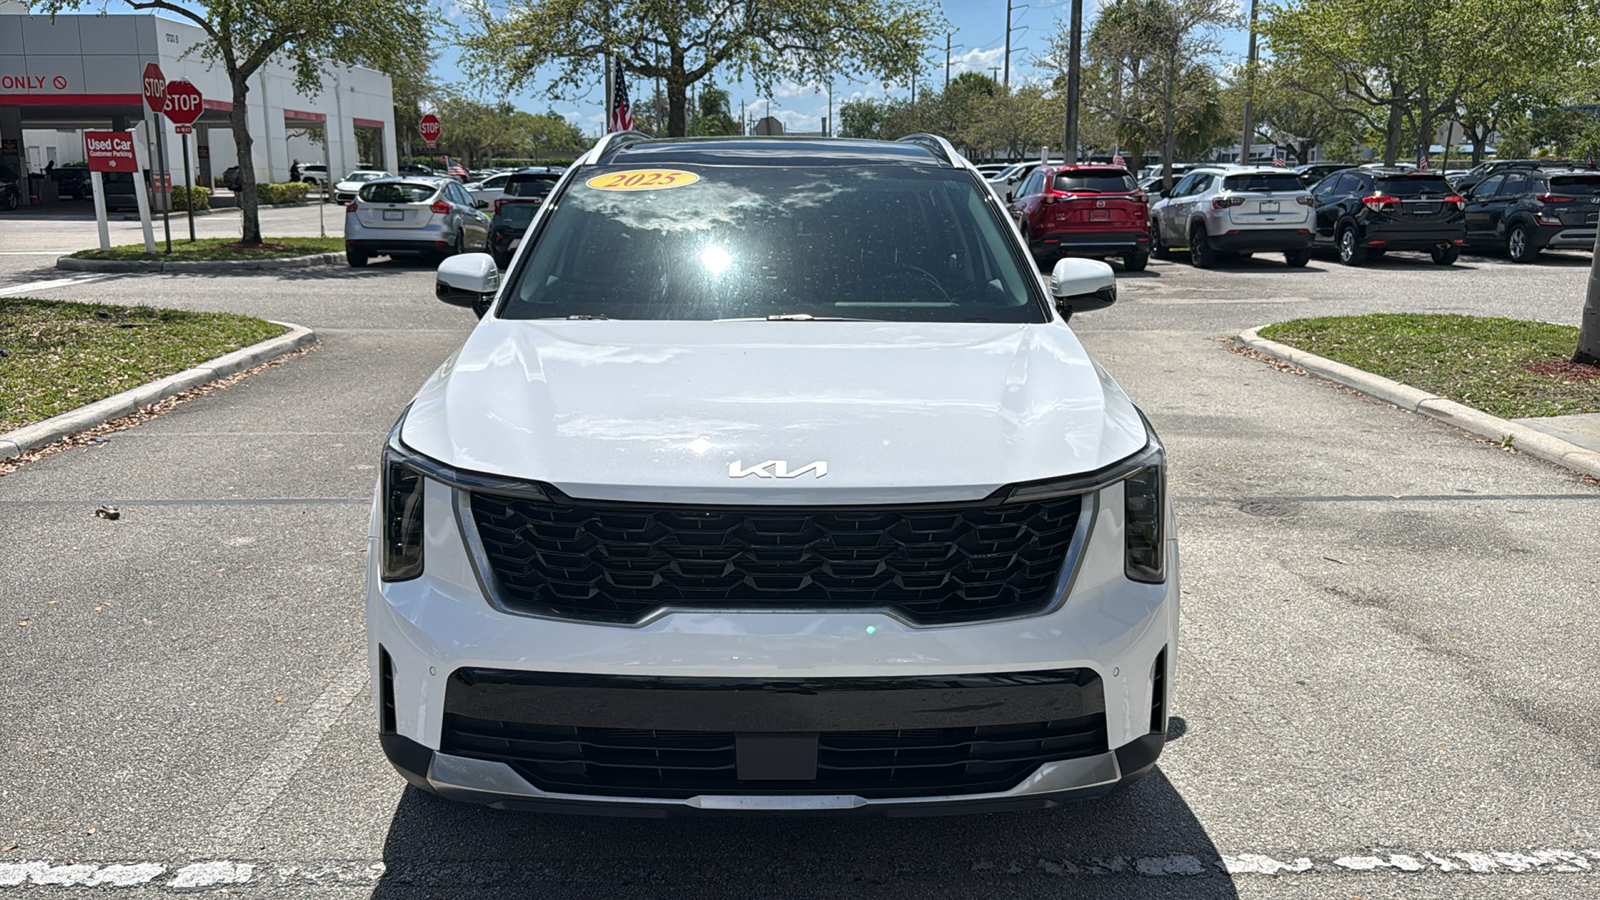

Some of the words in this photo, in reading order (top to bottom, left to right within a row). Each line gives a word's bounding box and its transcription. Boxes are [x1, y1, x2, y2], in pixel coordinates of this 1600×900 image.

[2, 76, 45, 89] ONLY
[145, 78, 164, 98] STOP
[421, 123, 439, 134] STOP
[87, 138, 112, 150] Used
[113, 138, 131, 150] Car
[112, 151, 133, 159] Parking
[604, 173, 681, 188] 2025
